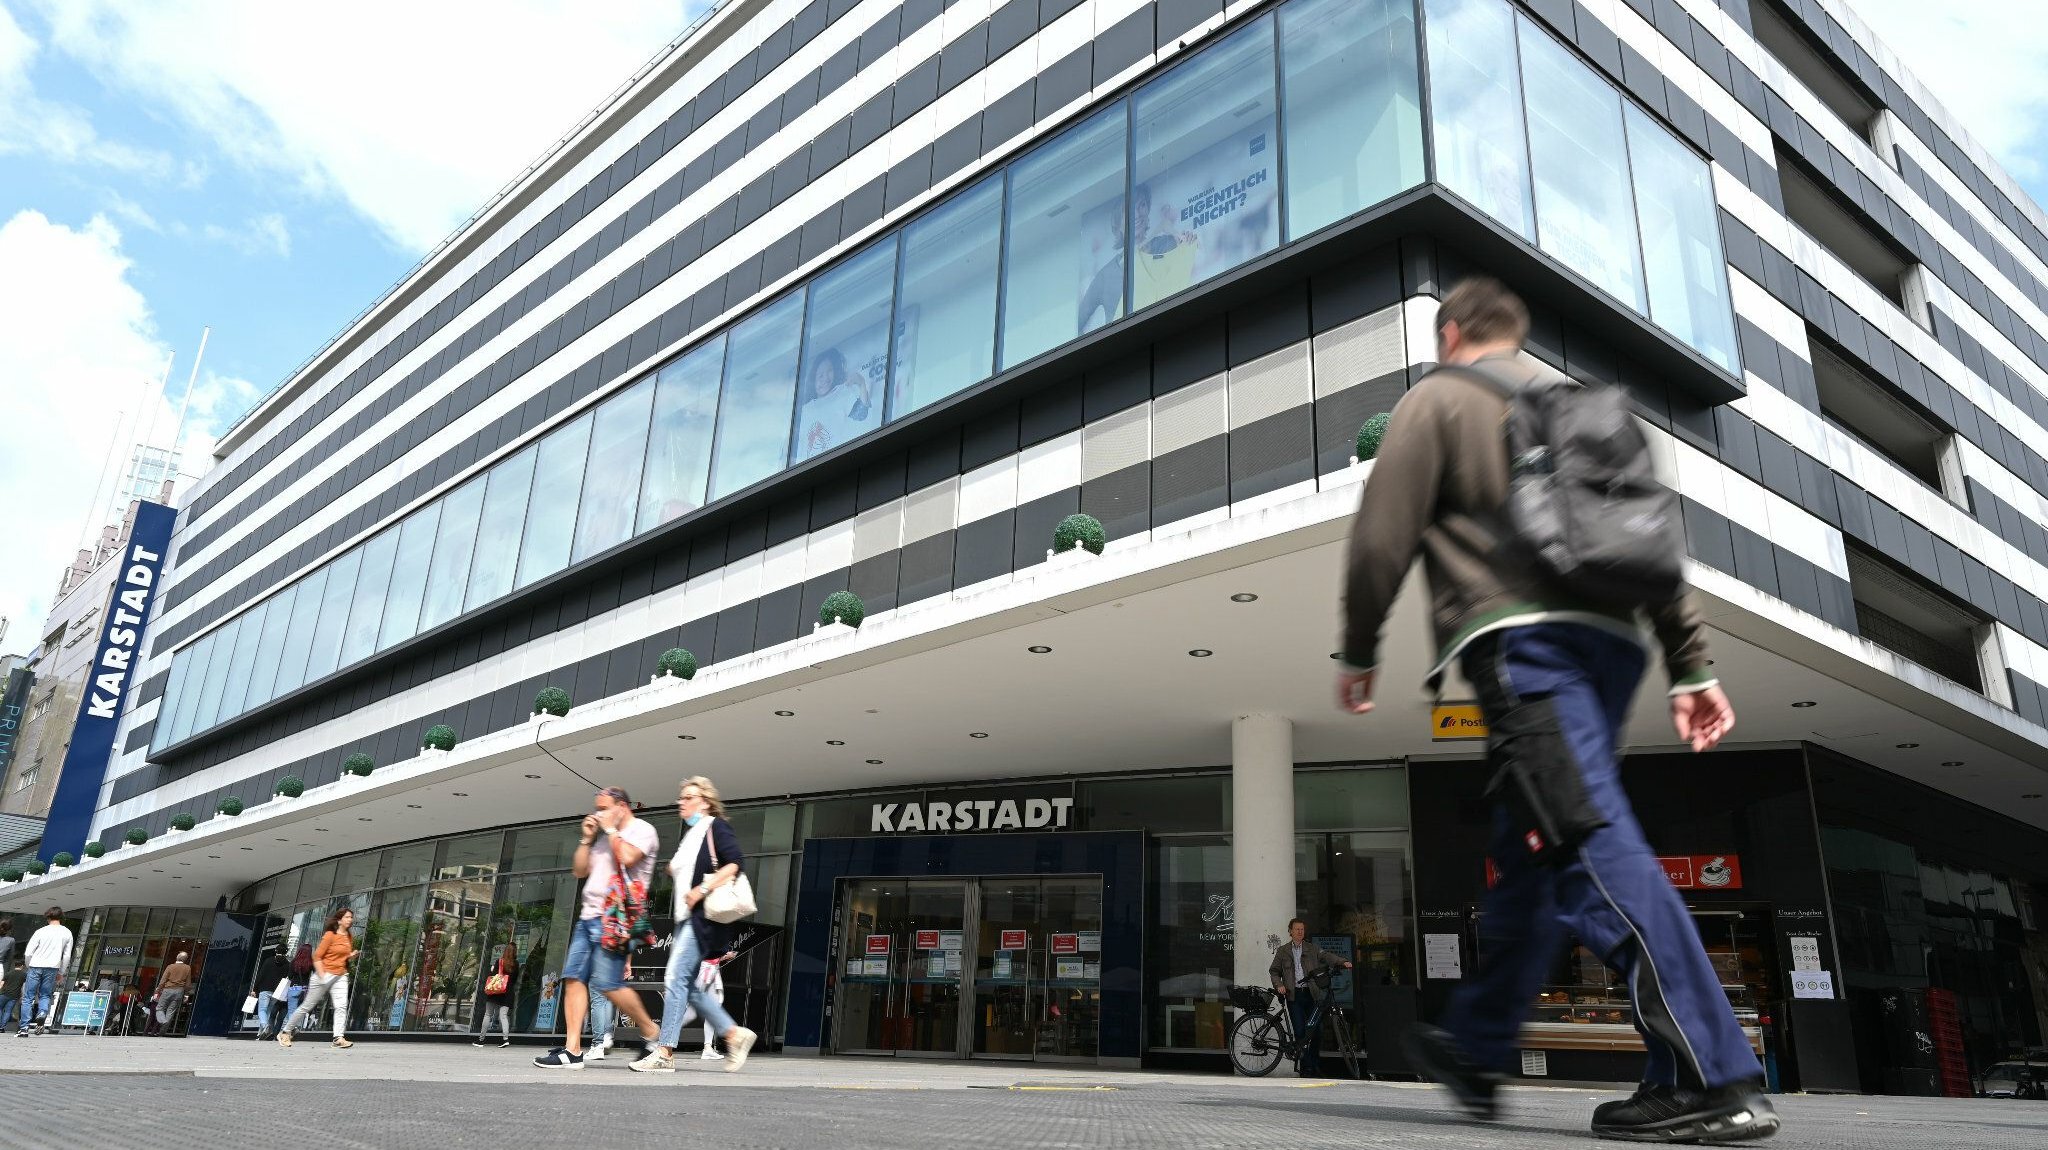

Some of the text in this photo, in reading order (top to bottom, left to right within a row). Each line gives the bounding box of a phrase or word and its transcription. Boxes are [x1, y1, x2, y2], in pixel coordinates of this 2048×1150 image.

[1180, 168, 1267, 222] EIGENTLICH
[1187, 186, 1215, 204] WARUM
[1192, 192, 1247, 230] NICHT?
[87, 545, 159, 719] KARSTADT
[0, 704, 21, 766] PRIM
[871, 798, 1074, 832] KARSTADT
[1797, 908, 1823, 918] Angebot
[1199, 933, 1216, 941] NEW
